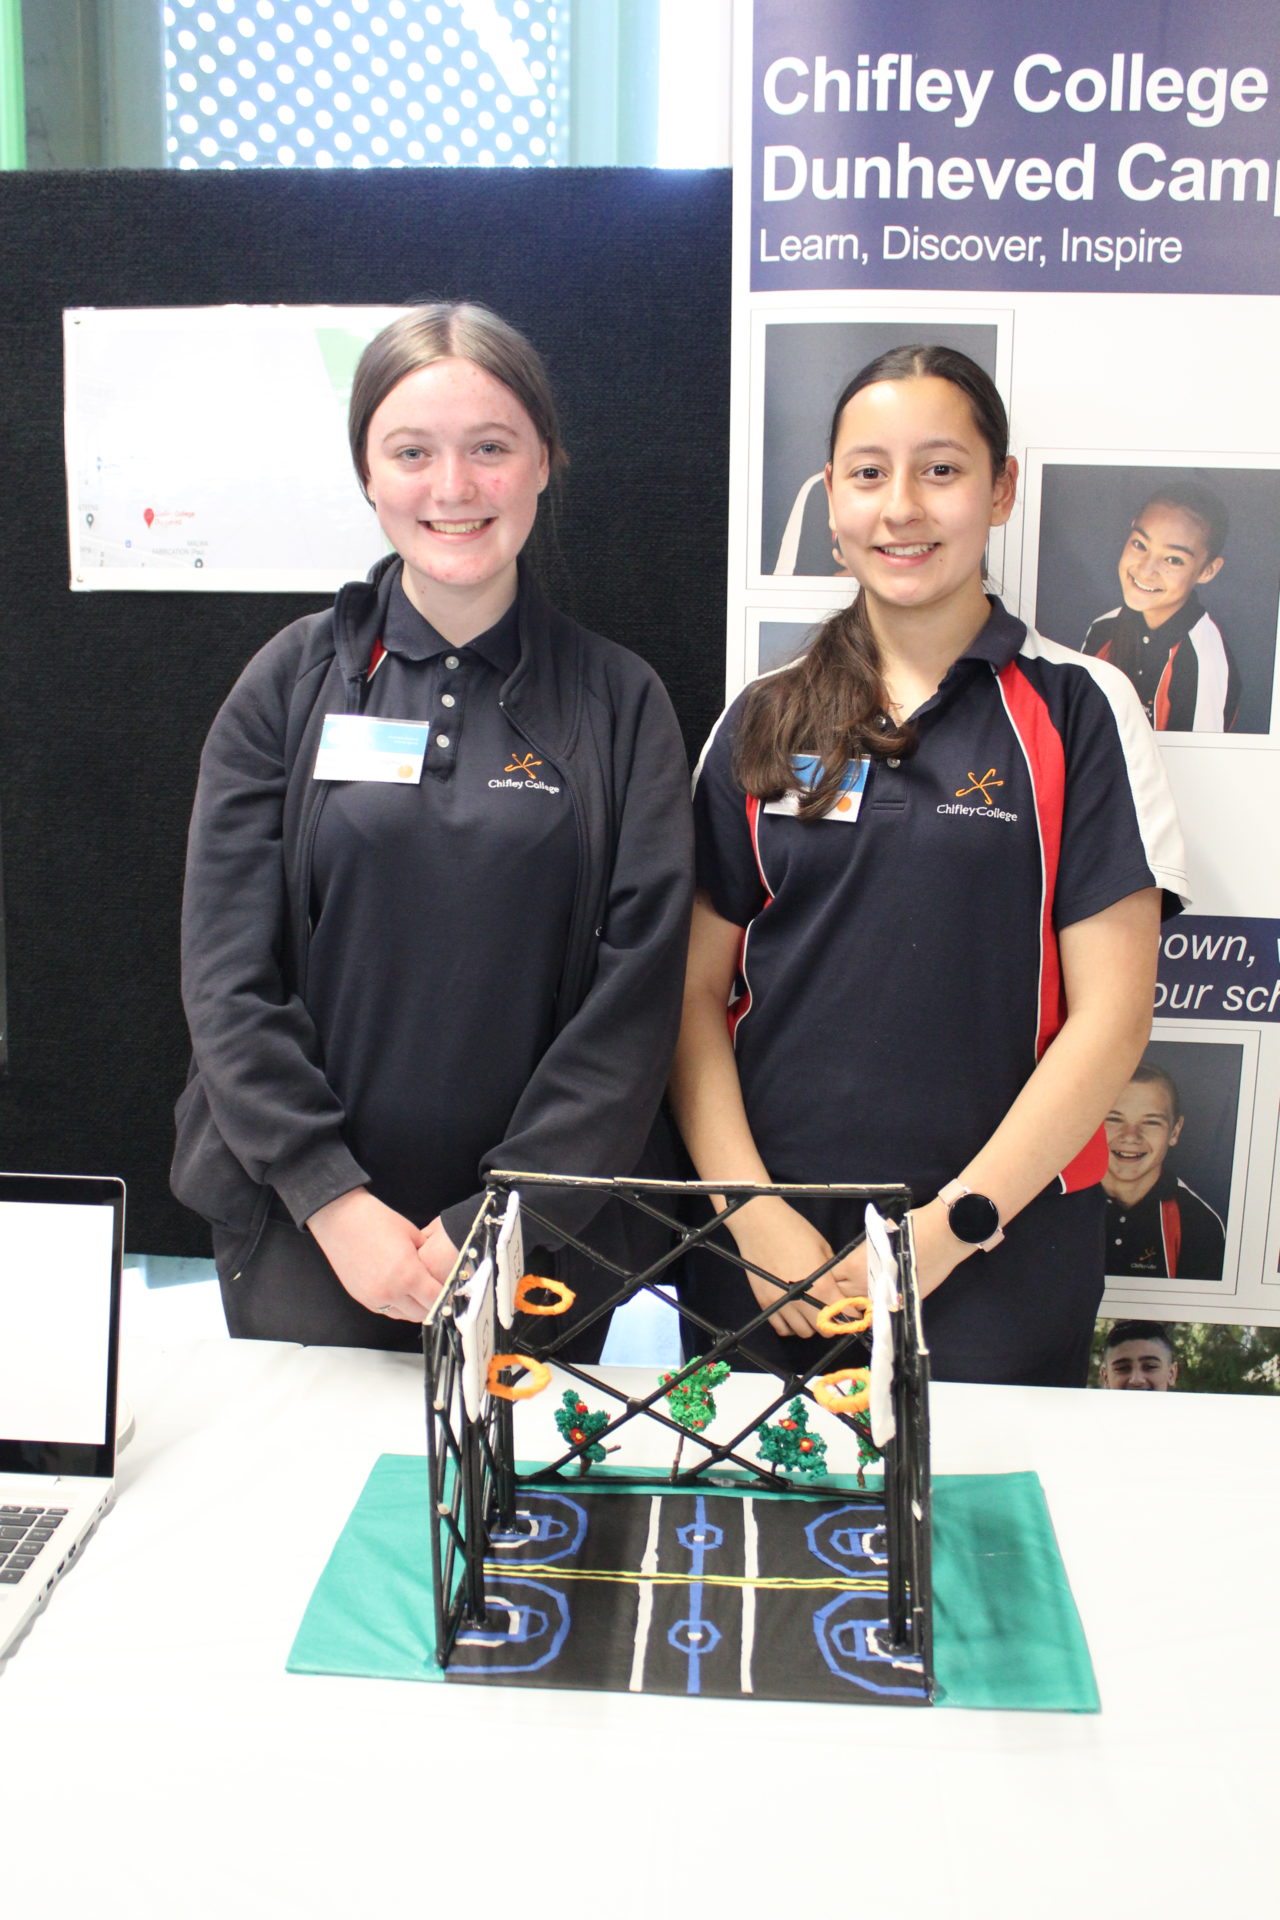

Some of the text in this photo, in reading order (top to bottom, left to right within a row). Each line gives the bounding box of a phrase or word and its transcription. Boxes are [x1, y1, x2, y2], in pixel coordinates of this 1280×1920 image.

[763, 54, 1269, 128] Chifley College
[764, 144, 1280, 217] Dunheved Cam
[761, 227, 1183, 272] Learn, Discover, Inspire
[488, 778, 560, 794] Chifley College
[936, 803, 1018, 822] Chifley College
[1158, 933, 1255, 968] own,
